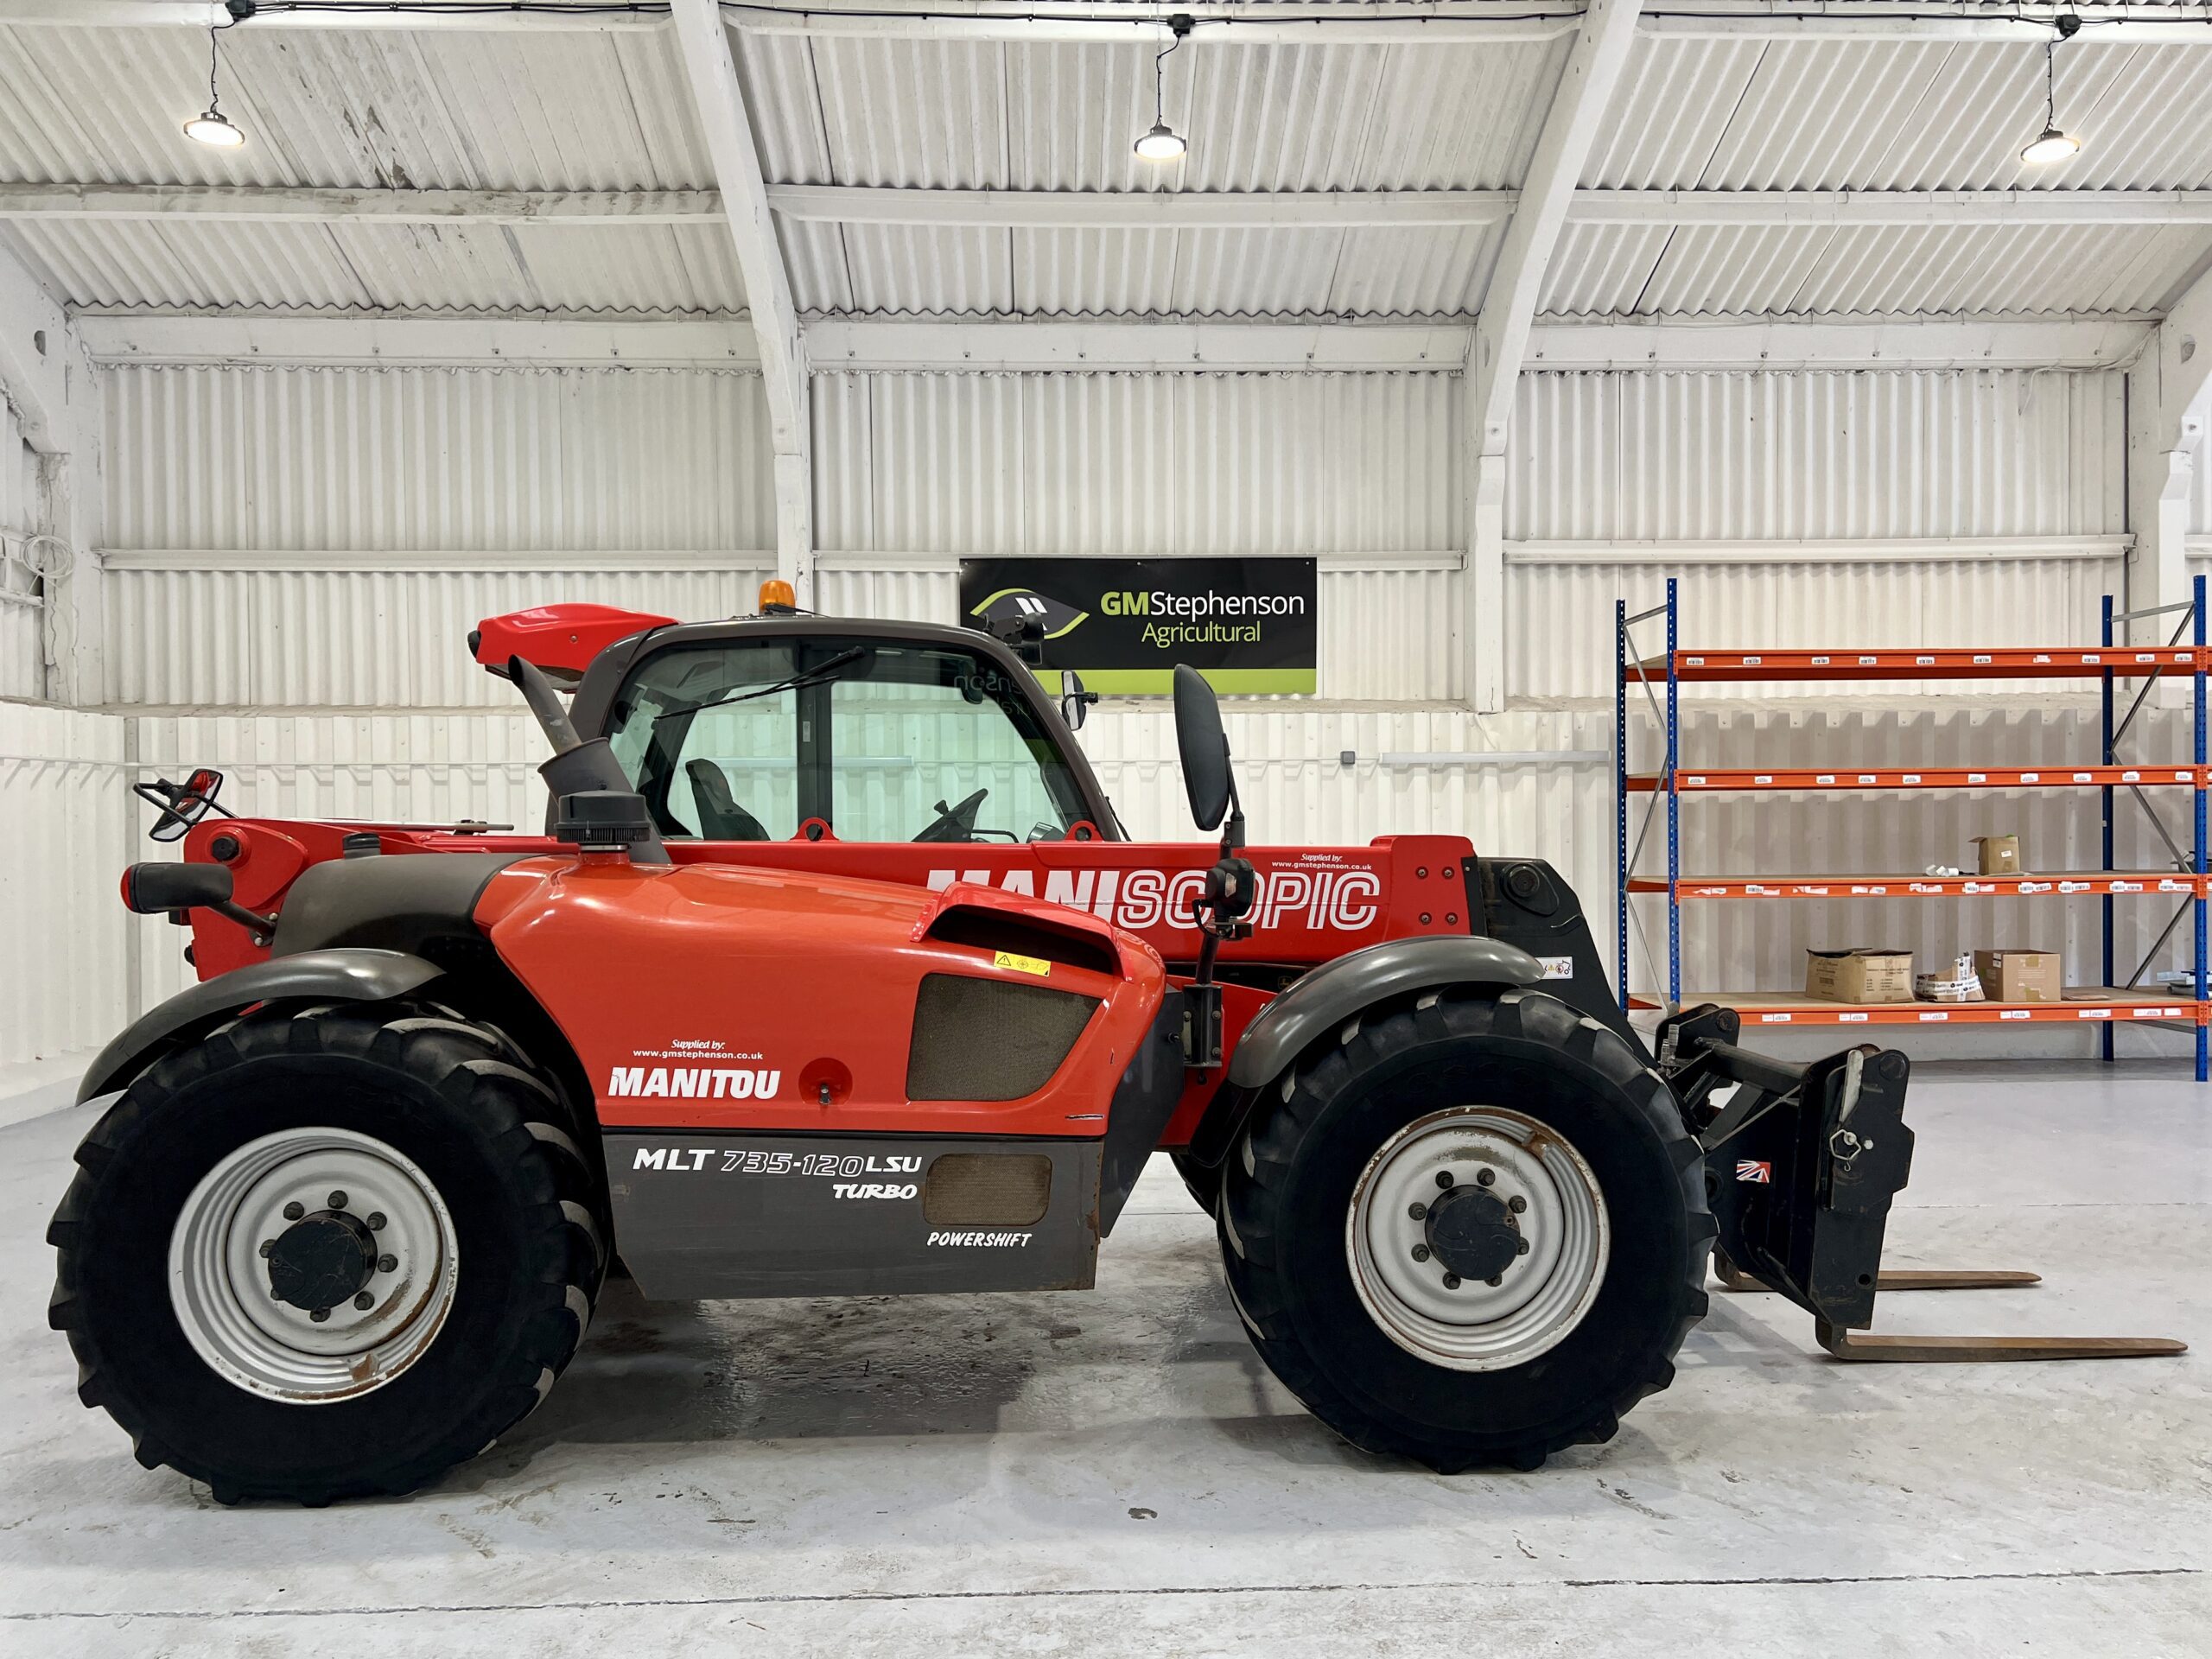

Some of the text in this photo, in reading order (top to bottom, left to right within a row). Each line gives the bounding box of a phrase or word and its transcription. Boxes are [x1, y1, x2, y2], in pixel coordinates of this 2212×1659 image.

[1100, 589, 1305, 623] GMStephenson
[1141, 620, 1262, 649] Agricultural
[1300, 853, 1331, 861] Supplied
[1271, 861, 1372, 871] www.gmstephenson.co.uk
[671, 1039, 709, 1050] Supplied
[633, 1049, 763, 1060] www.gmstephenson.co.uk
[607, 1066, 781, 1100] MANITOU
[632, 1147, 716, 1171] MLT
[832, 1183, 918, 1200] TURBO
[926, 1231, 1033, 1248] POWERSHIFT
